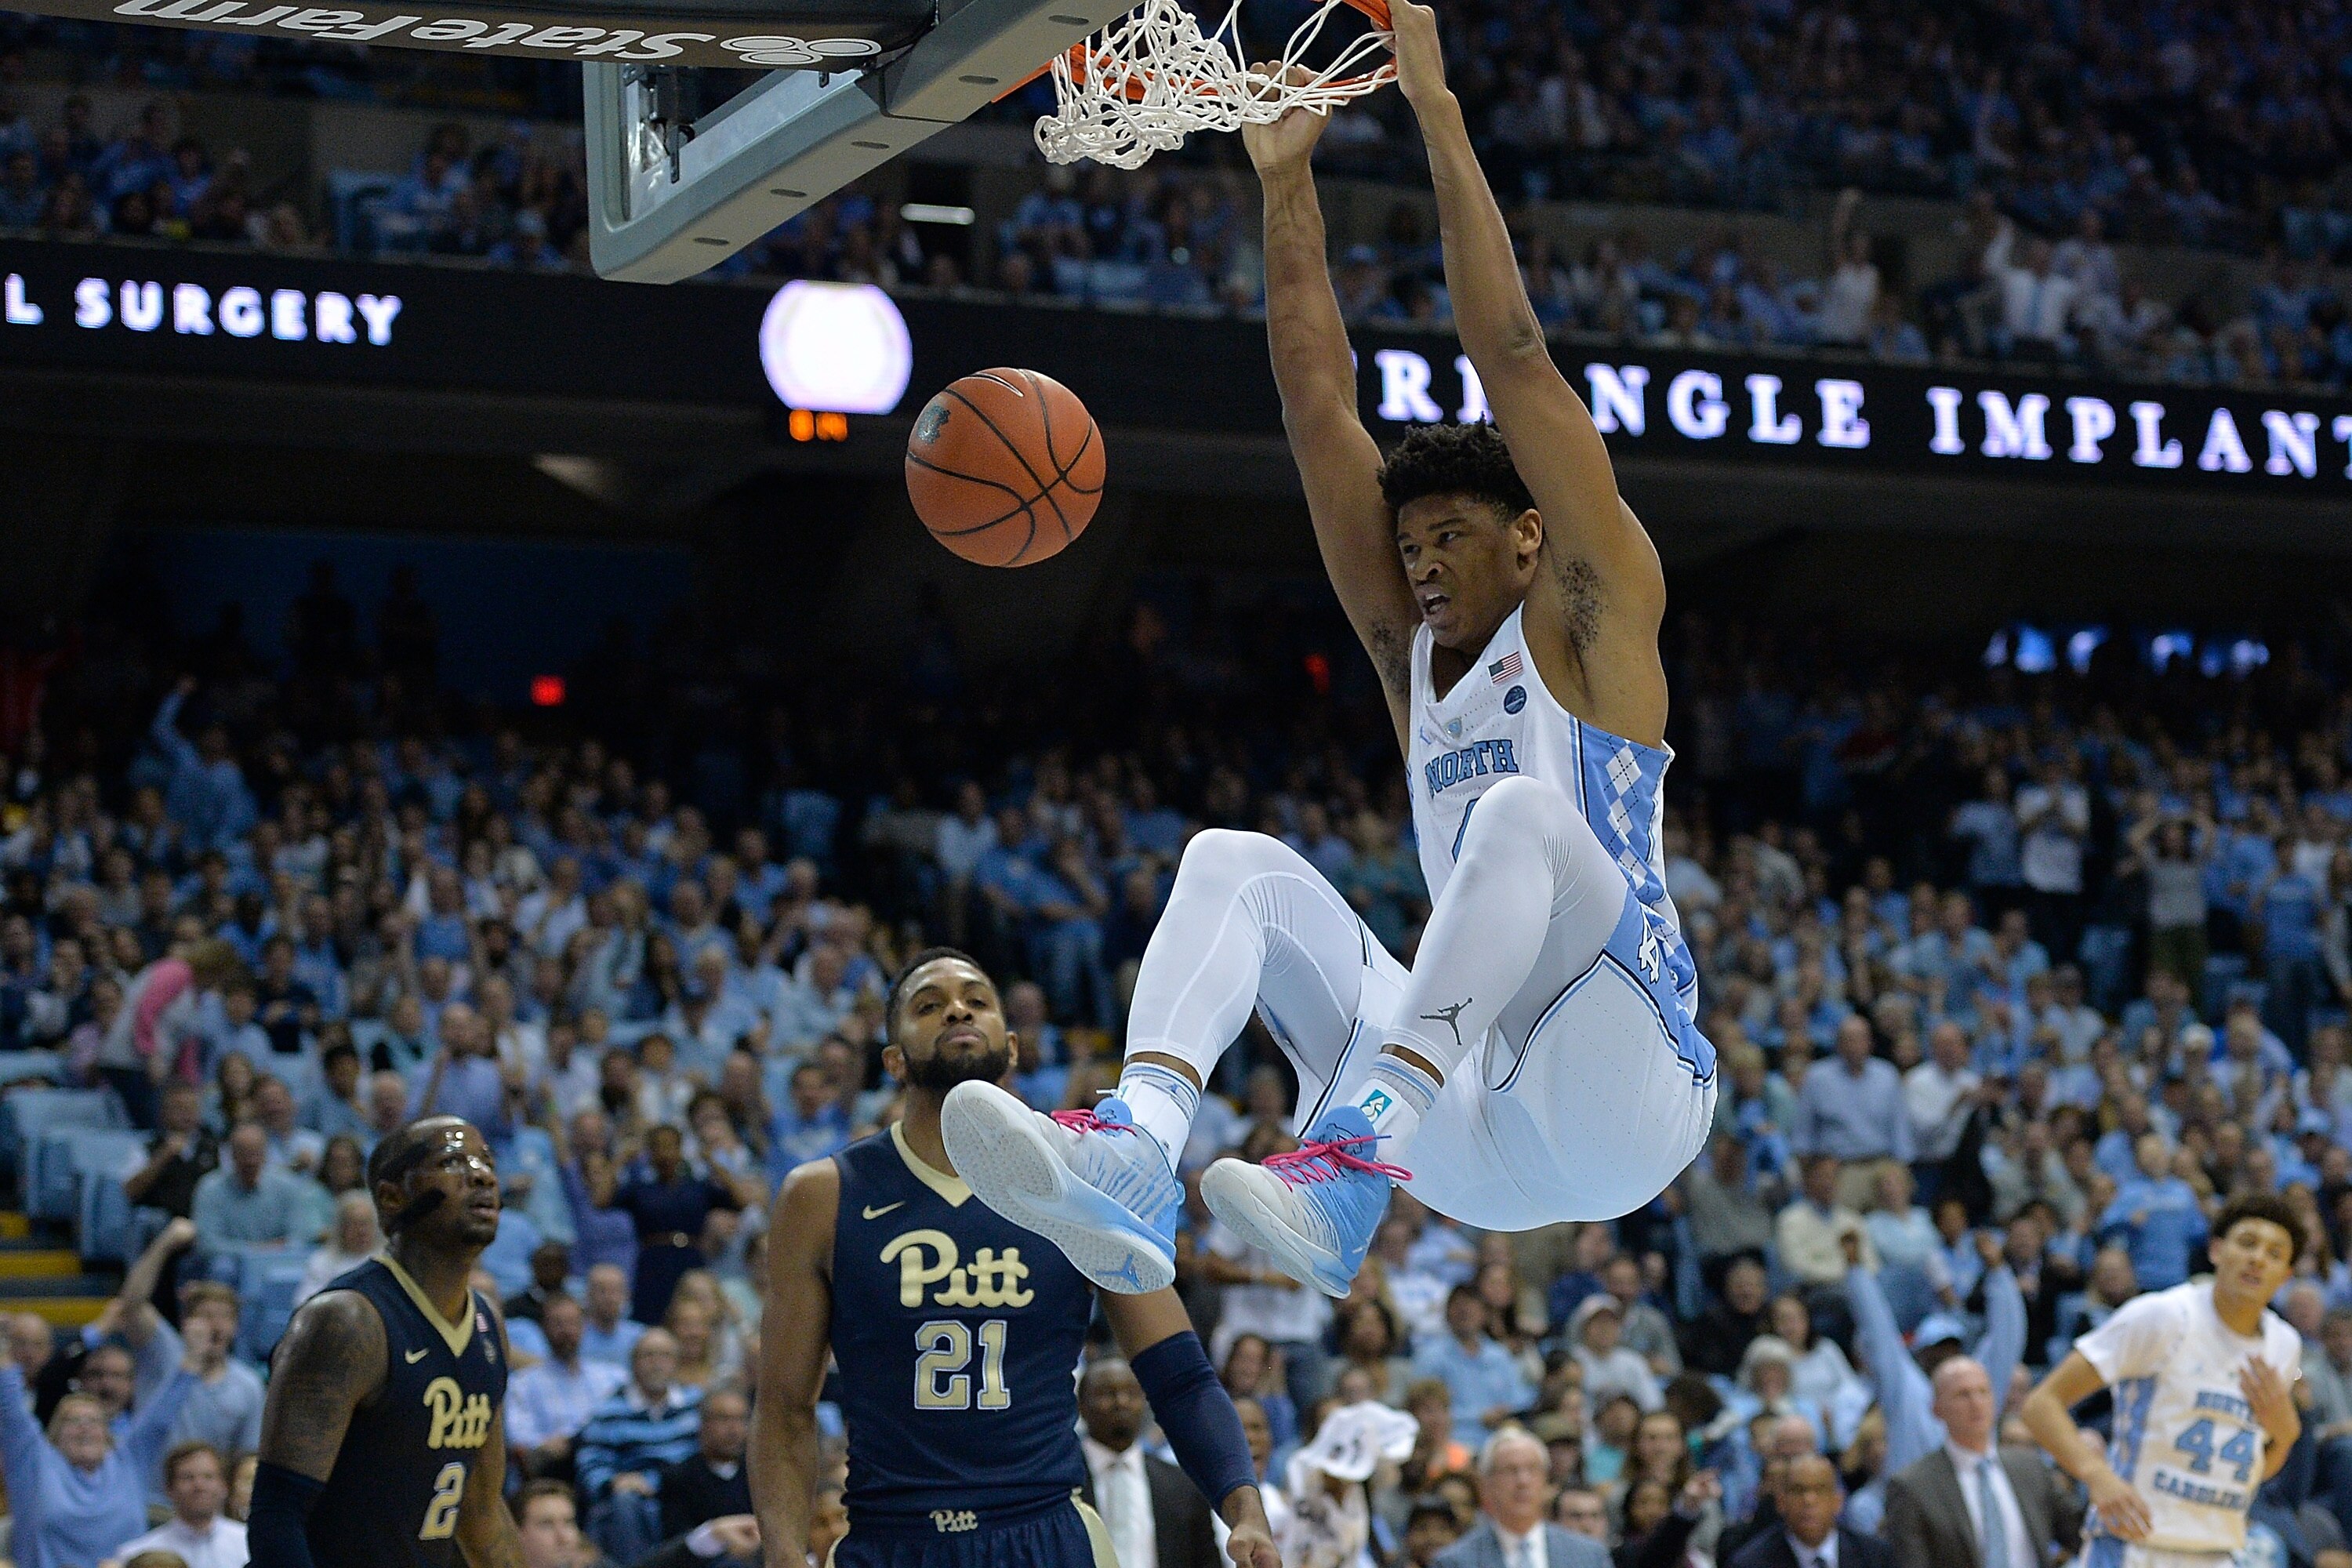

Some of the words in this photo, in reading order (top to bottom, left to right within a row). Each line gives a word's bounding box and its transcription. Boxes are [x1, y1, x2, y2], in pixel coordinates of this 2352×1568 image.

[5, 273, 43, 325] L
[74, 277, 402, 346] SURGERY
[1350, 349, 1871, 448] RINGLE
[1425, 739, 1520, 798] NORTH
[880, 1229, 1035, 1308] Pitt
[914, 1319, 1011, 1410] 21
[423, 1376, 492, 1450] Pitt
[2175, 1418, 2256, 1483] 44
[418, 1461, 466, 1541] 2
[929, 1510, 978, 1534] Pitt
